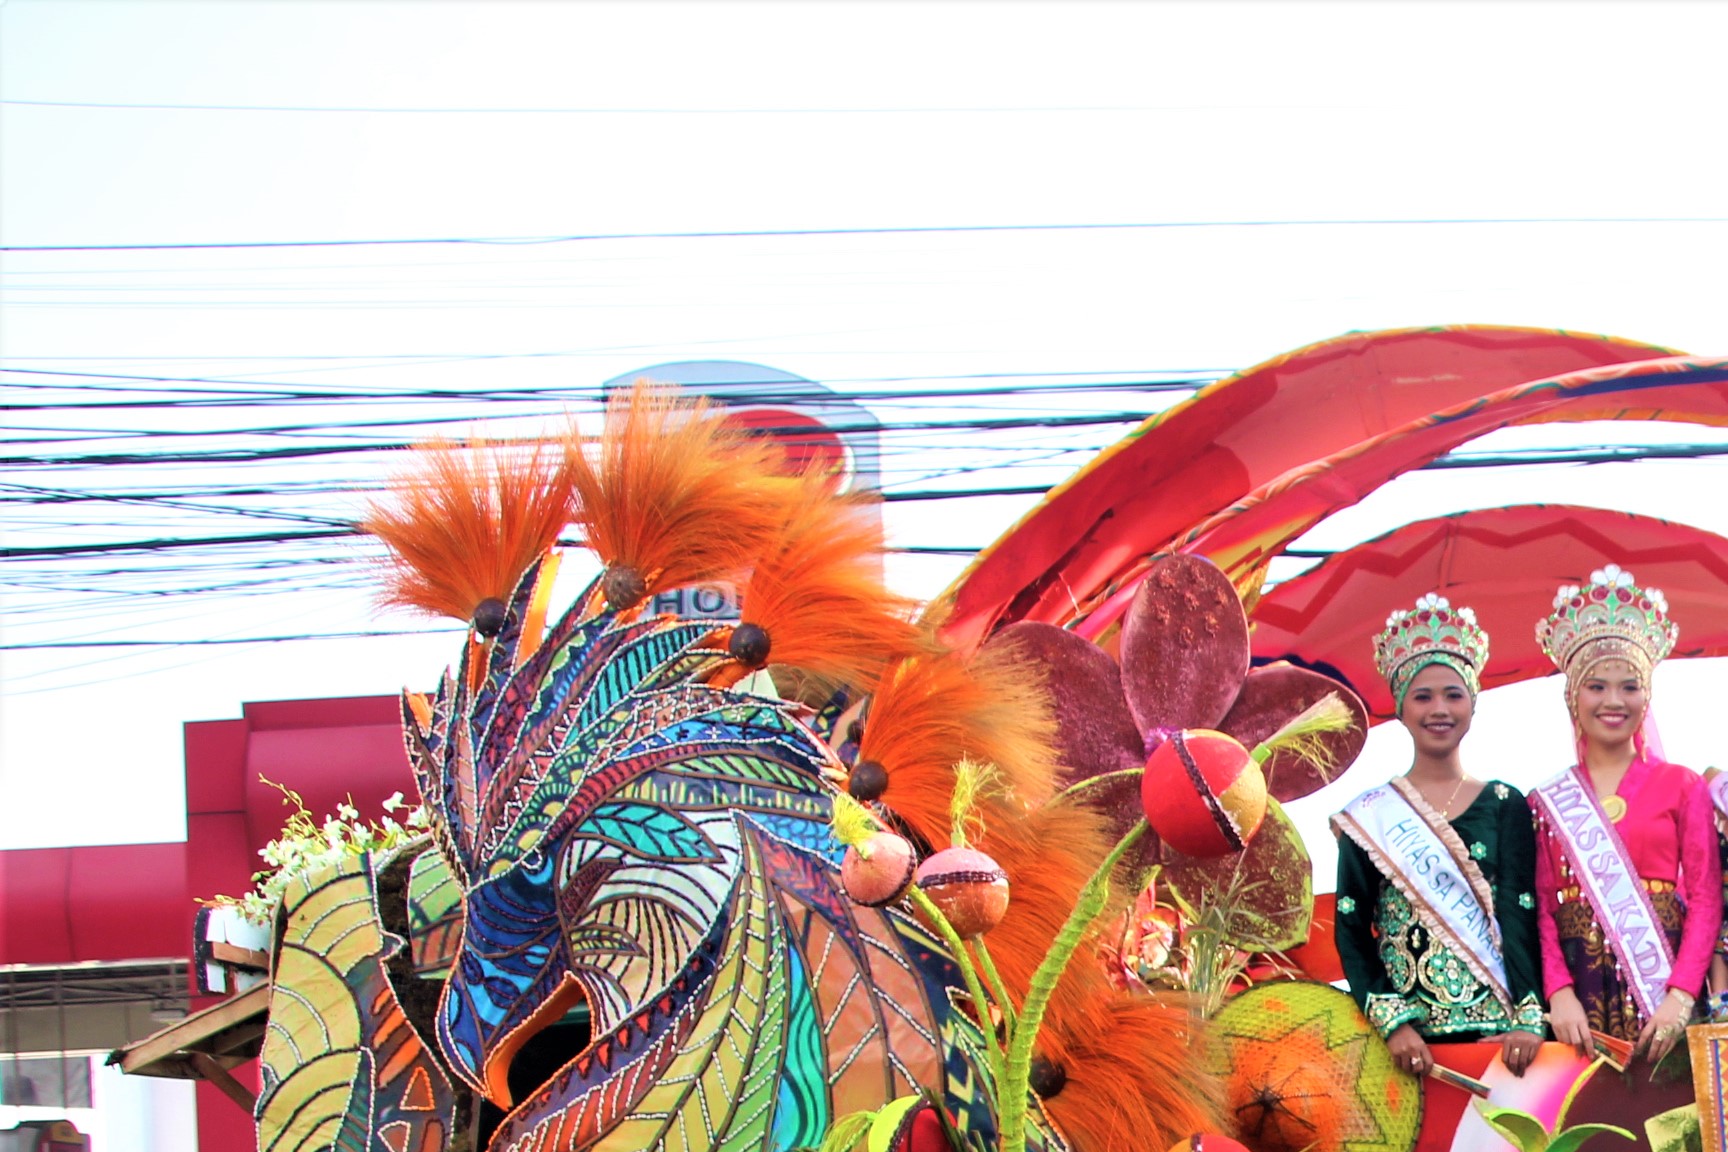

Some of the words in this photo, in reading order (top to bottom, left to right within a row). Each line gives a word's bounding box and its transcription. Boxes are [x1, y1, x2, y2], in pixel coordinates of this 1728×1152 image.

[1385, 818, 1440, 876] HIYAS
[1428, 871, 1456, 901] SA
[1450, 892, 1504, 967] PANAG
[1540, 774, 1607, 851] HIYAS
[1587, 851, 1623, 898] SA
